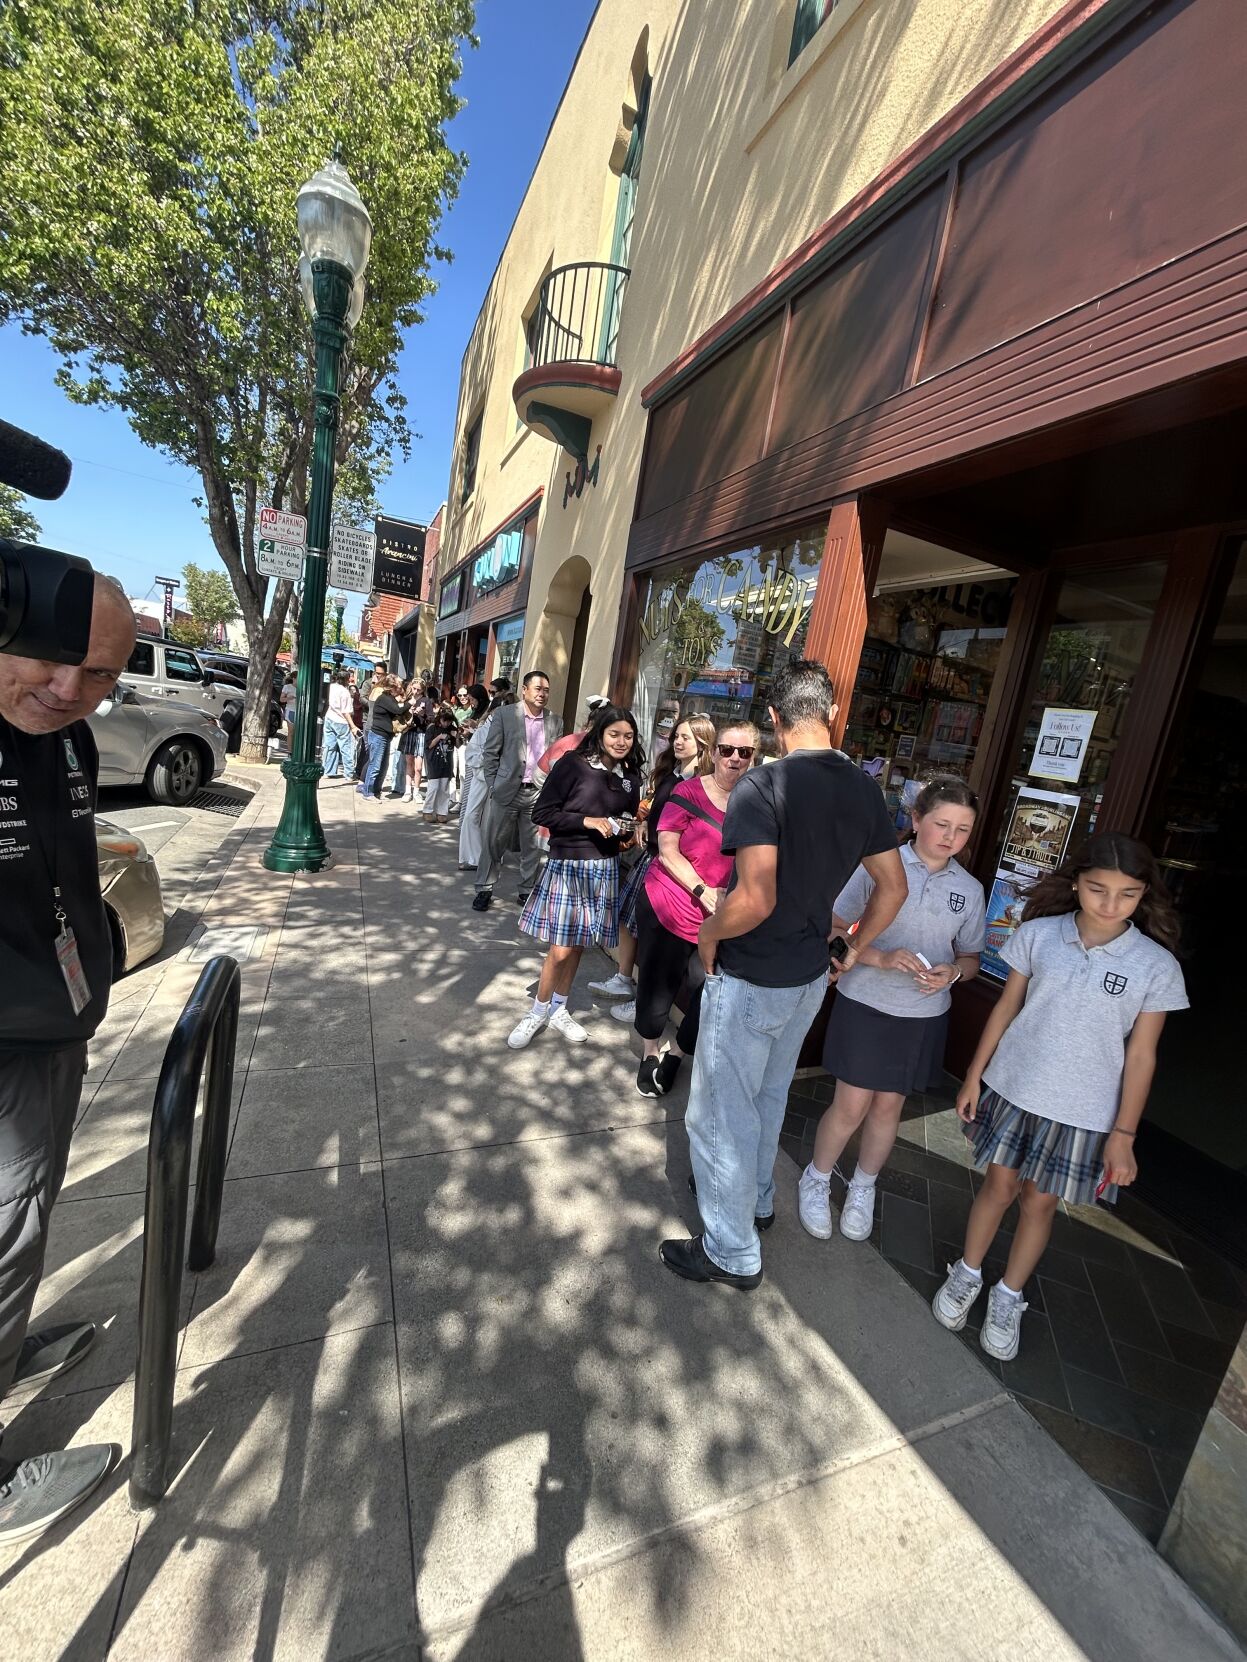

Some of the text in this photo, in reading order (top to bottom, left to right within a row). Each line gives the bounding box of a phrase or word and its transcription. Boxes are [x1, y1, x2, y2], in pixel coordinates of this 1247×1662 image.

[262, 511, 303, 528] NO PARKING
[346, 532, 371, 542] BICYCLES
[264, 540, 271, 552] 2
[334, 536, 373, 550] SKATEBOARDS
[382, 539, 418, 552] BISTRO
[276, 549, 300, 560] PARKING
[338, 544, 358, 554] SKATES
[334, 550, 352, 560] ROLLER
[338, 560, 356, 568] RIDING
[338, 567, 364, 577] SIDEWALK
[380, 570, 406, 580] LUNCH
[382, 576, 411, 588] DINNER
[686, 574, 715, 608] FOR
[717, 560, 814, 648] CANDY
[681, 636, 720, 666] TOYS
[1050, 721, 1070, 732] Follow
[0, 796, 18, 811] BS
[9, 844, 30, 852] Packard
